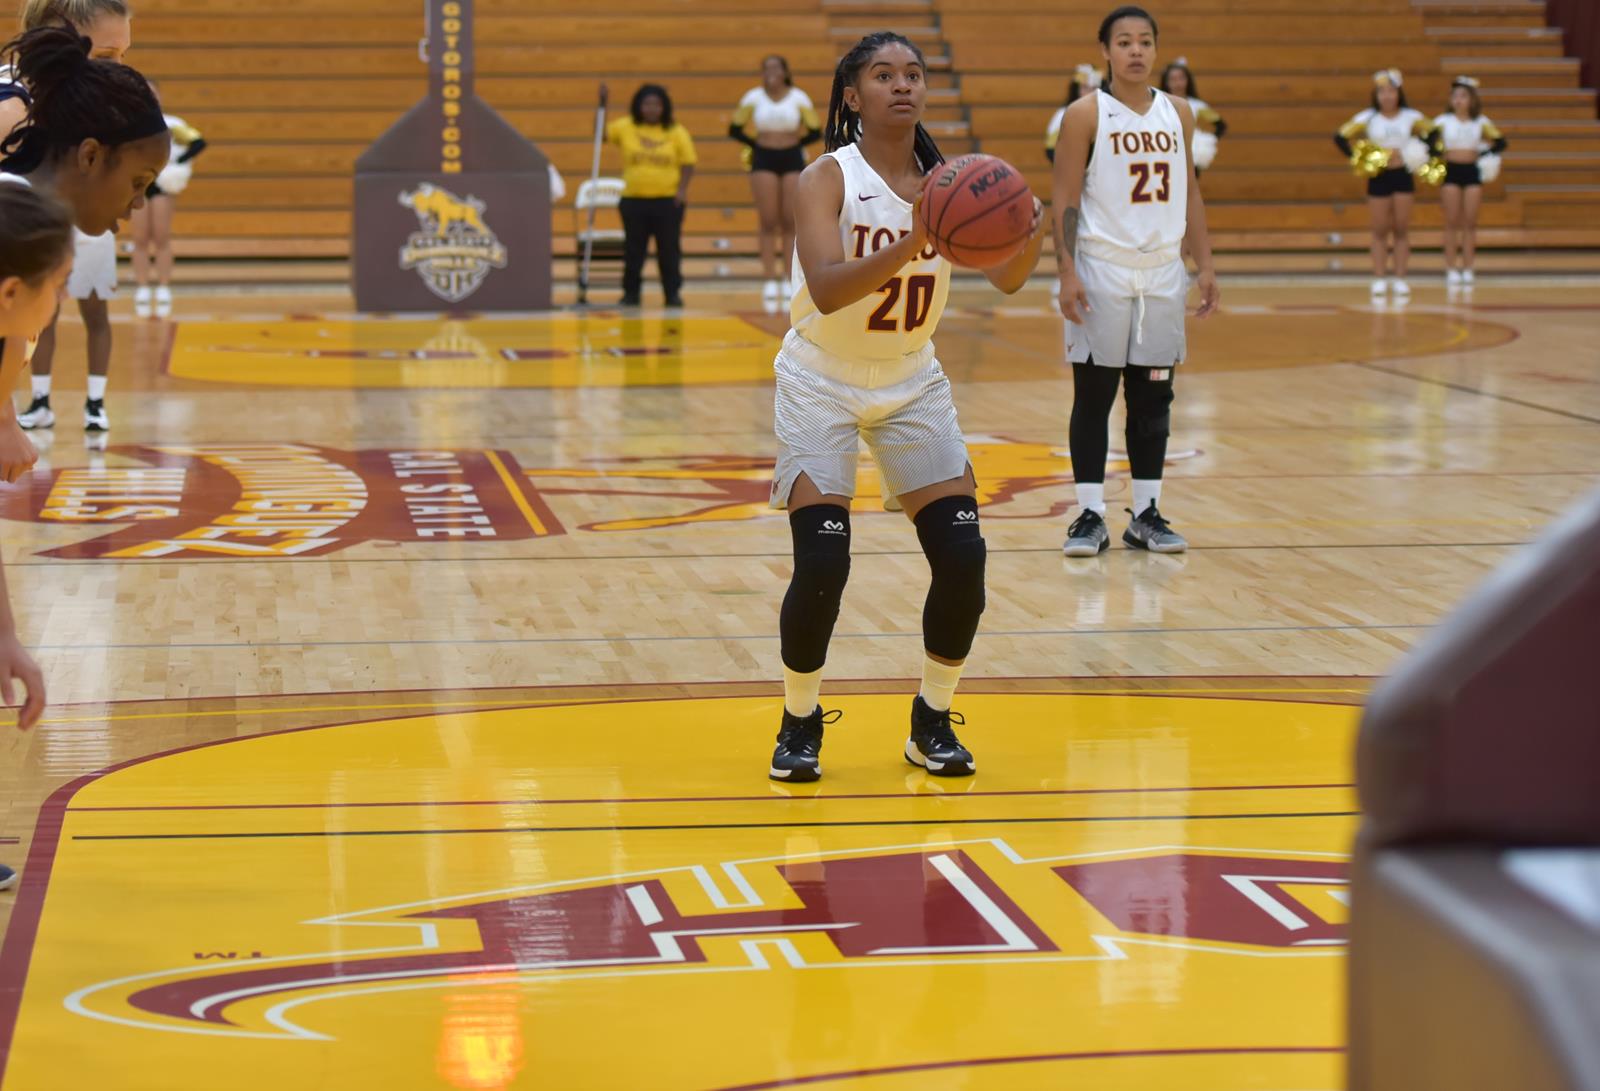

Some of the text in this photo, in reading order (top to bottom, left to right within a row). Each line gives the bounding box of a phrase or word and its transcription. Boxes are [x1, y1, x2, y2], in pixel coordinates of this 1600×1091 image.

[1130, 162, 1169, 204] 23
[865, 273, 936, 332] 20
[40, 467, 186, 521] HILLS
[104, 444, 369, 557] DOMINGUEZ
[389, 451, 497, 538] CAL STATE
